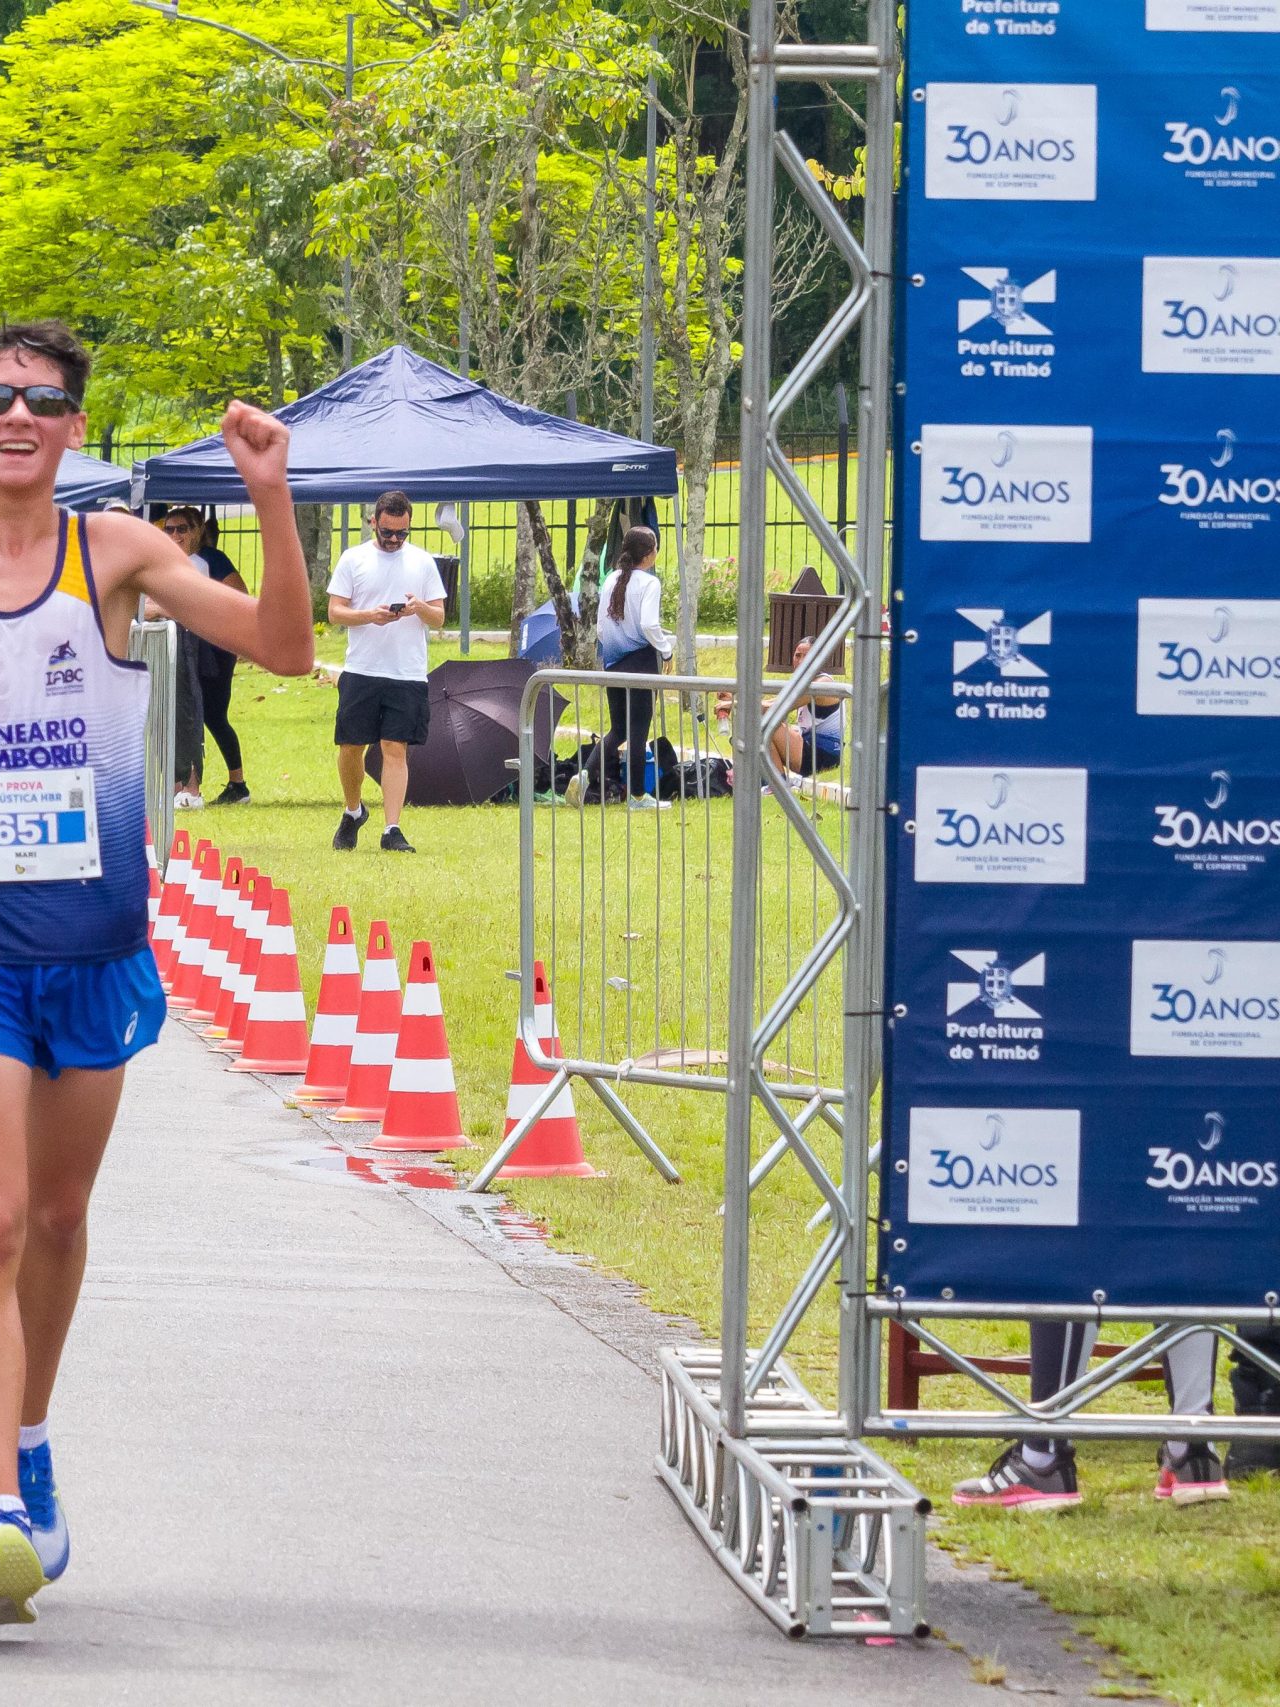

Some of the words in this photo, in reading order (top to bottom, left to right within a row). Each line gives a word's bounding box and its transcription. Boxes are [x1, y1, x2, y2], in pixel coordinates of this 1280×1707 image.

[962, 0, 1059, 14] Prefeitura
[965, 19, 990, 35] de
[994, 19, 1056, 35] Timbó
[957, 339, 1055, 356] Prefeitura
[960, 361, 986, 377] de
[990, 361, 1052, 377] Timbó
[953, 681, 1050, 698] Prefeitura
[955, 703, 980, 719] de
[985, 703, 1047, 719] Timbó
[7, 782, 43, 791] PROVA
[946, 1023, 1043, 1040] Prefeitura
[949, 1045, 974, 1060] de
[981, 1045, 1040, 1060] Timbó
